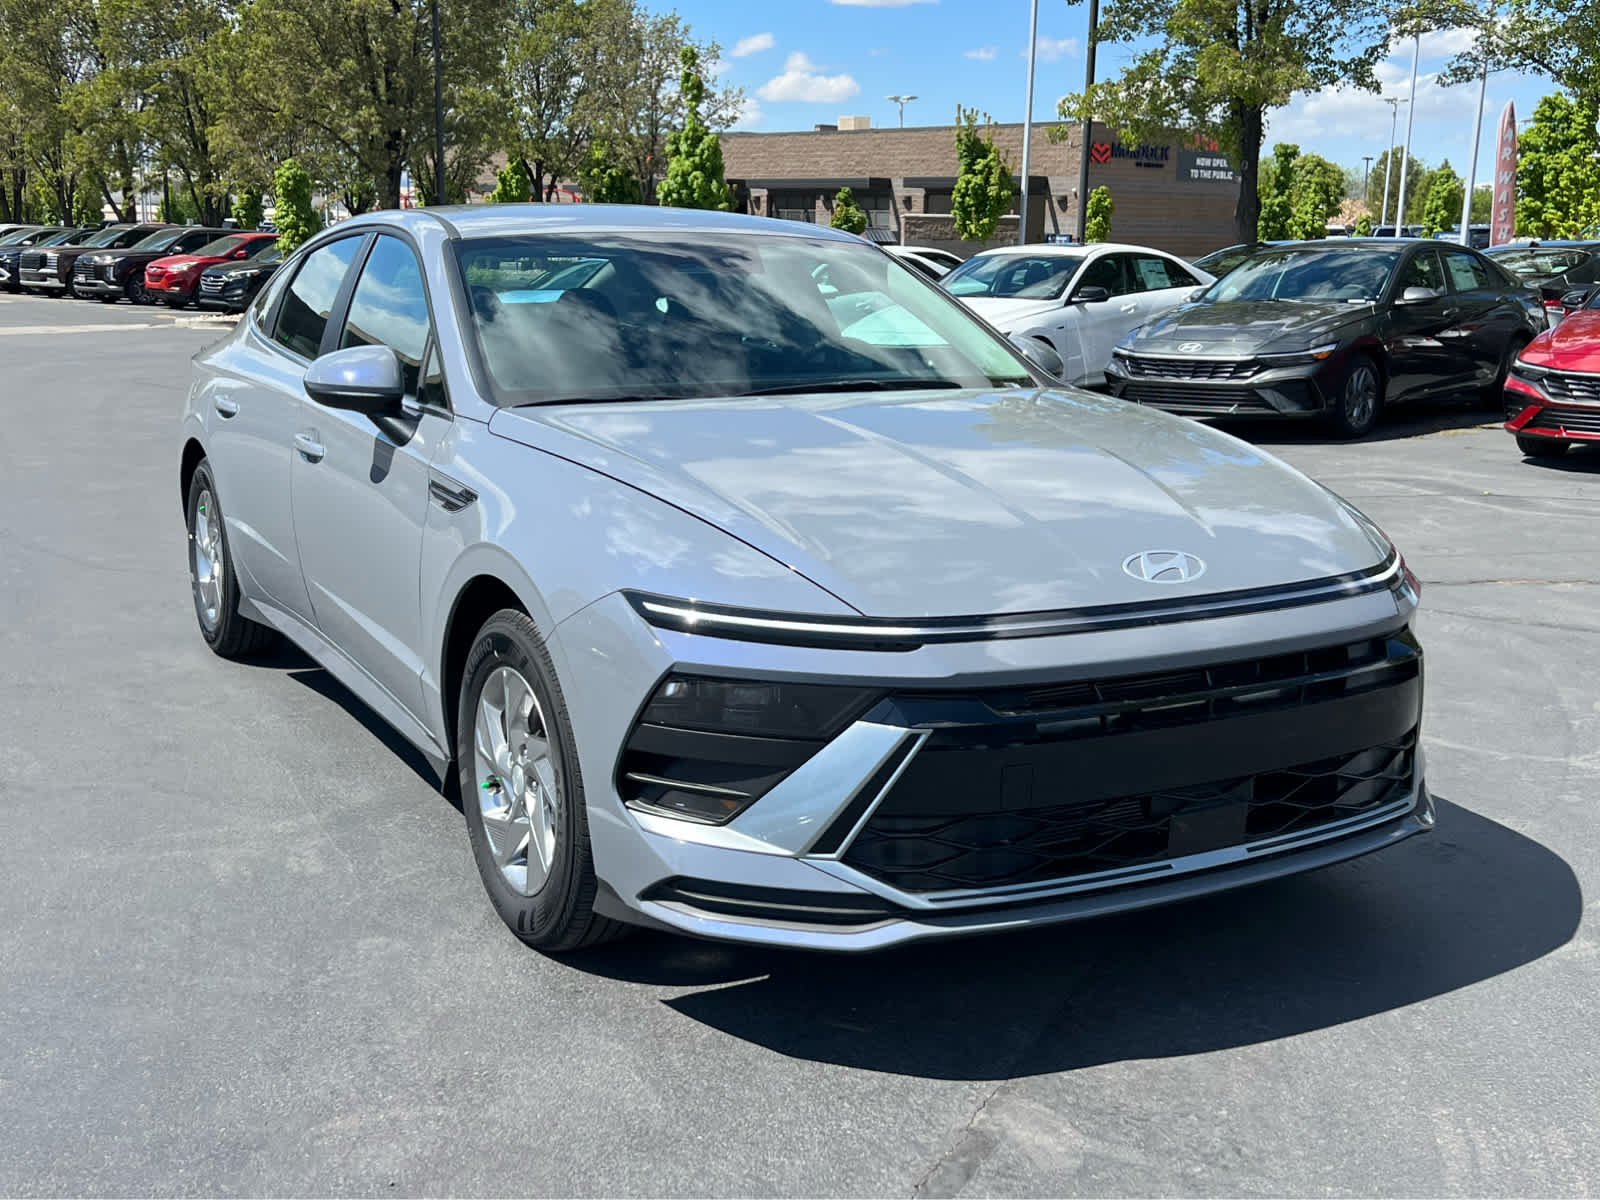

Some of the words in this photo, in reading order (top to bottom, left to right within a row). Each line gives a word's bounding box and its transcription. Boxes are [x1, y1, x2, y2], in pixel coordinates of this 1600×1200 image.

[1196, 157, 1211, 167] NOW
[1190, 169, 1199, 179] TO
[1200, 169, 1211, 179] THE
[1212, 170, 1233, 180] PUBLIC
[1498, 171, 1513, 239] WASH
